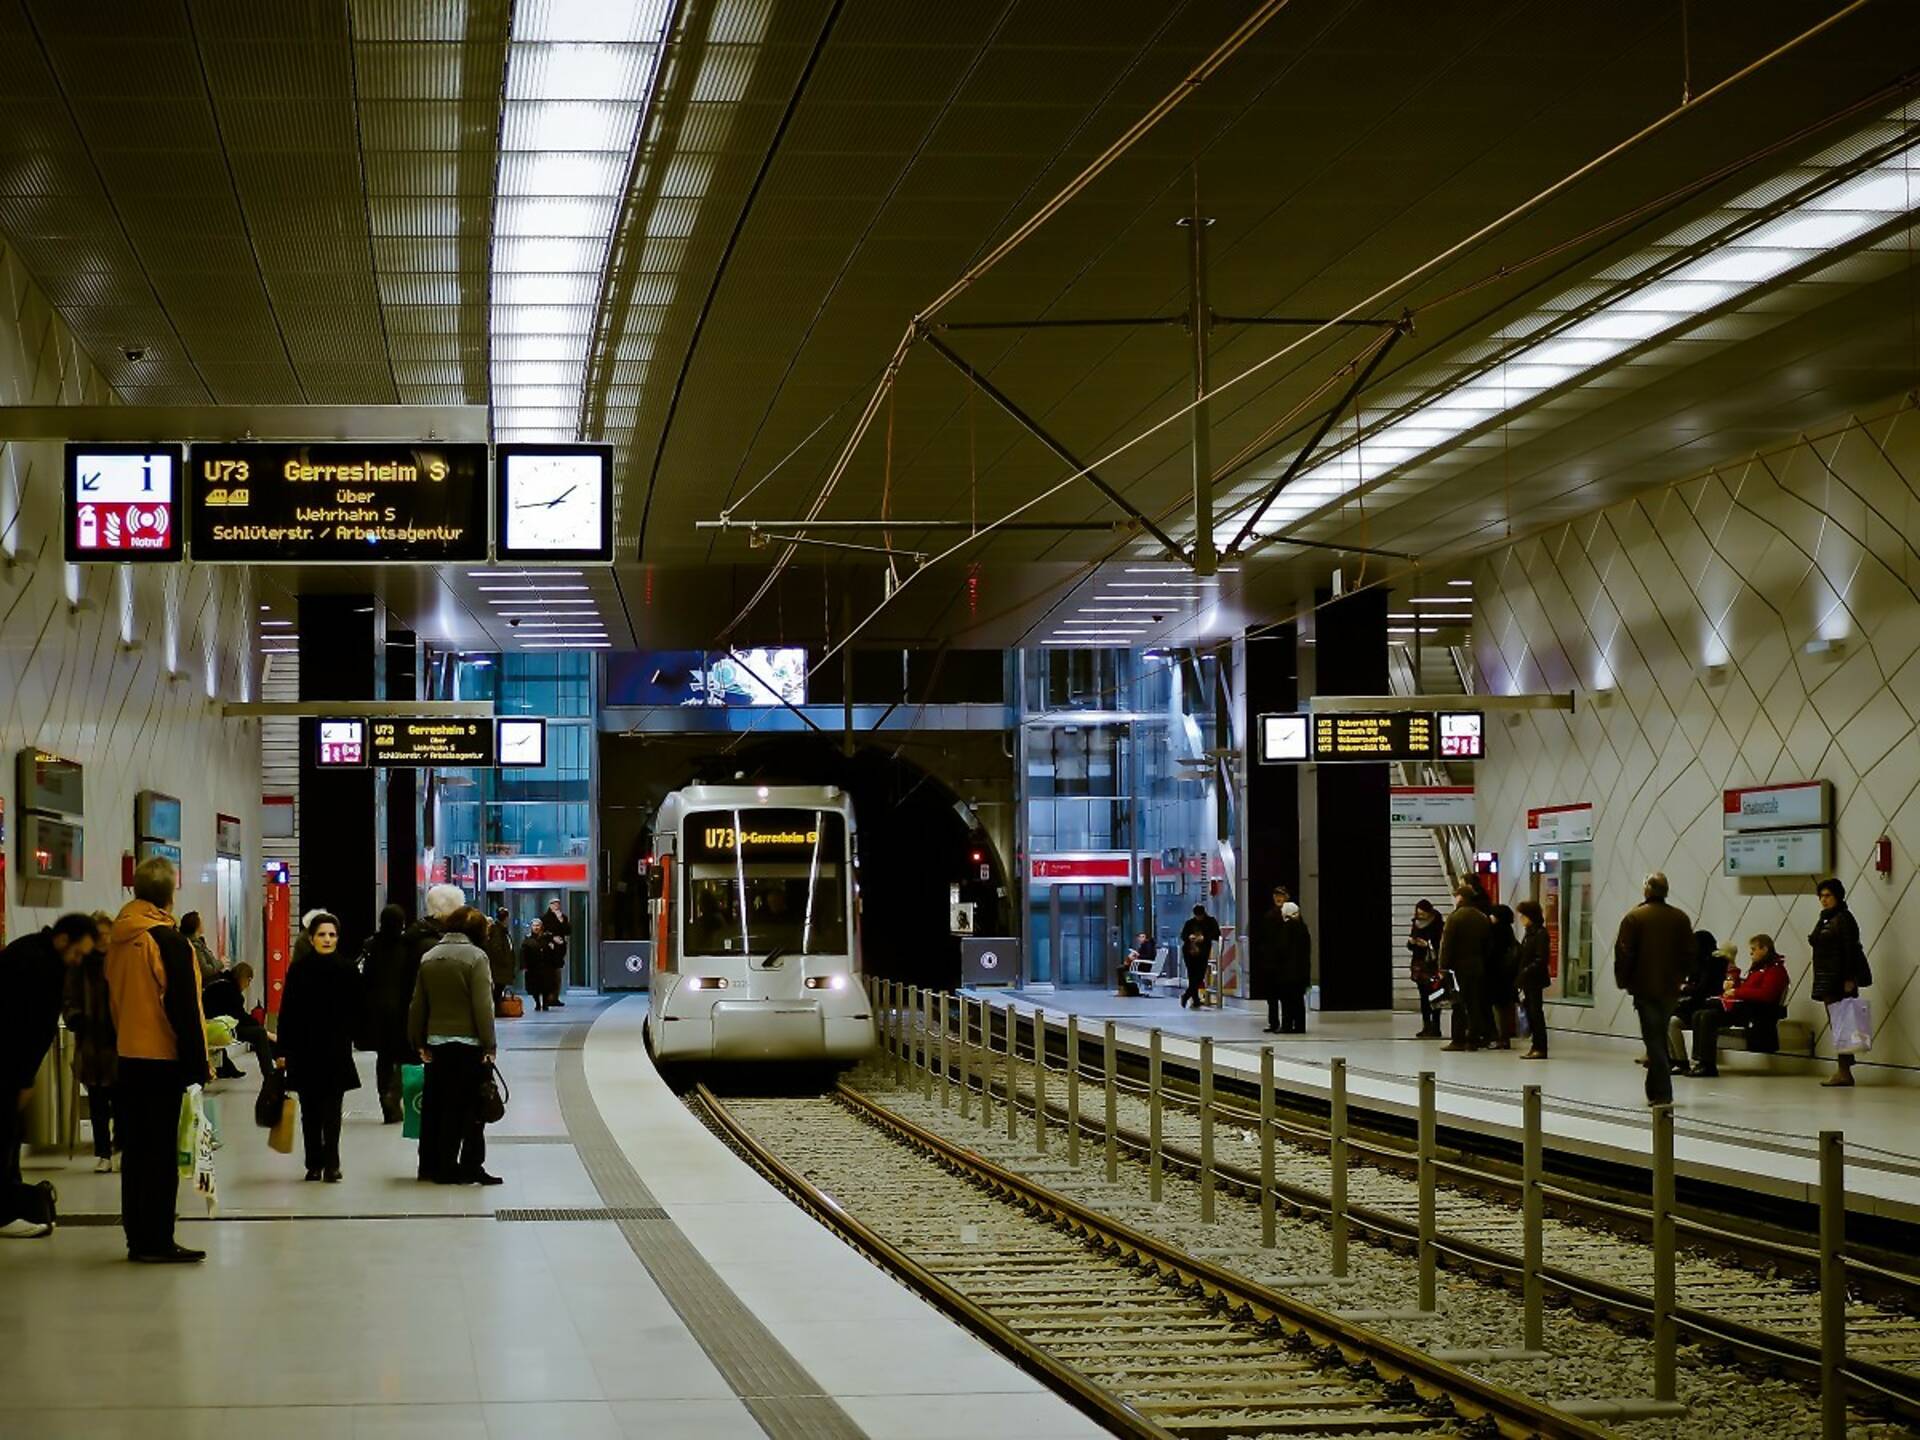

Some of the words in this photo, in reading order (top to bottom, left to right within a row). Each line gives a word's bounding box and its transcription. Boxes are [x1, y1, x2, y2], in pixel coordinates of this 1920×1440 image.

[142, 455, 153, 491] i
[204, 461, 249, 482] U73
[284, 461, 418, 482] Gerresheim
[430, 461, 446, 482] S
[336, 488, 375, 503] über
[296, 507, 378, 521] Wehrhahn
[385, 507, 396, 521] S
[131, 536, 163, 547] Notruf
[213, 525, 314, 541] Schlüterstr.
[319, 528, 331, 539] /
[335, 525, 463, 543] Arbeitsagentur
[375, 724, 395, 736] U73
[408, 724, 465, 736] Gerresheim
[468, 725, 477, 736] S
[705, 828, 735, 849] U73
